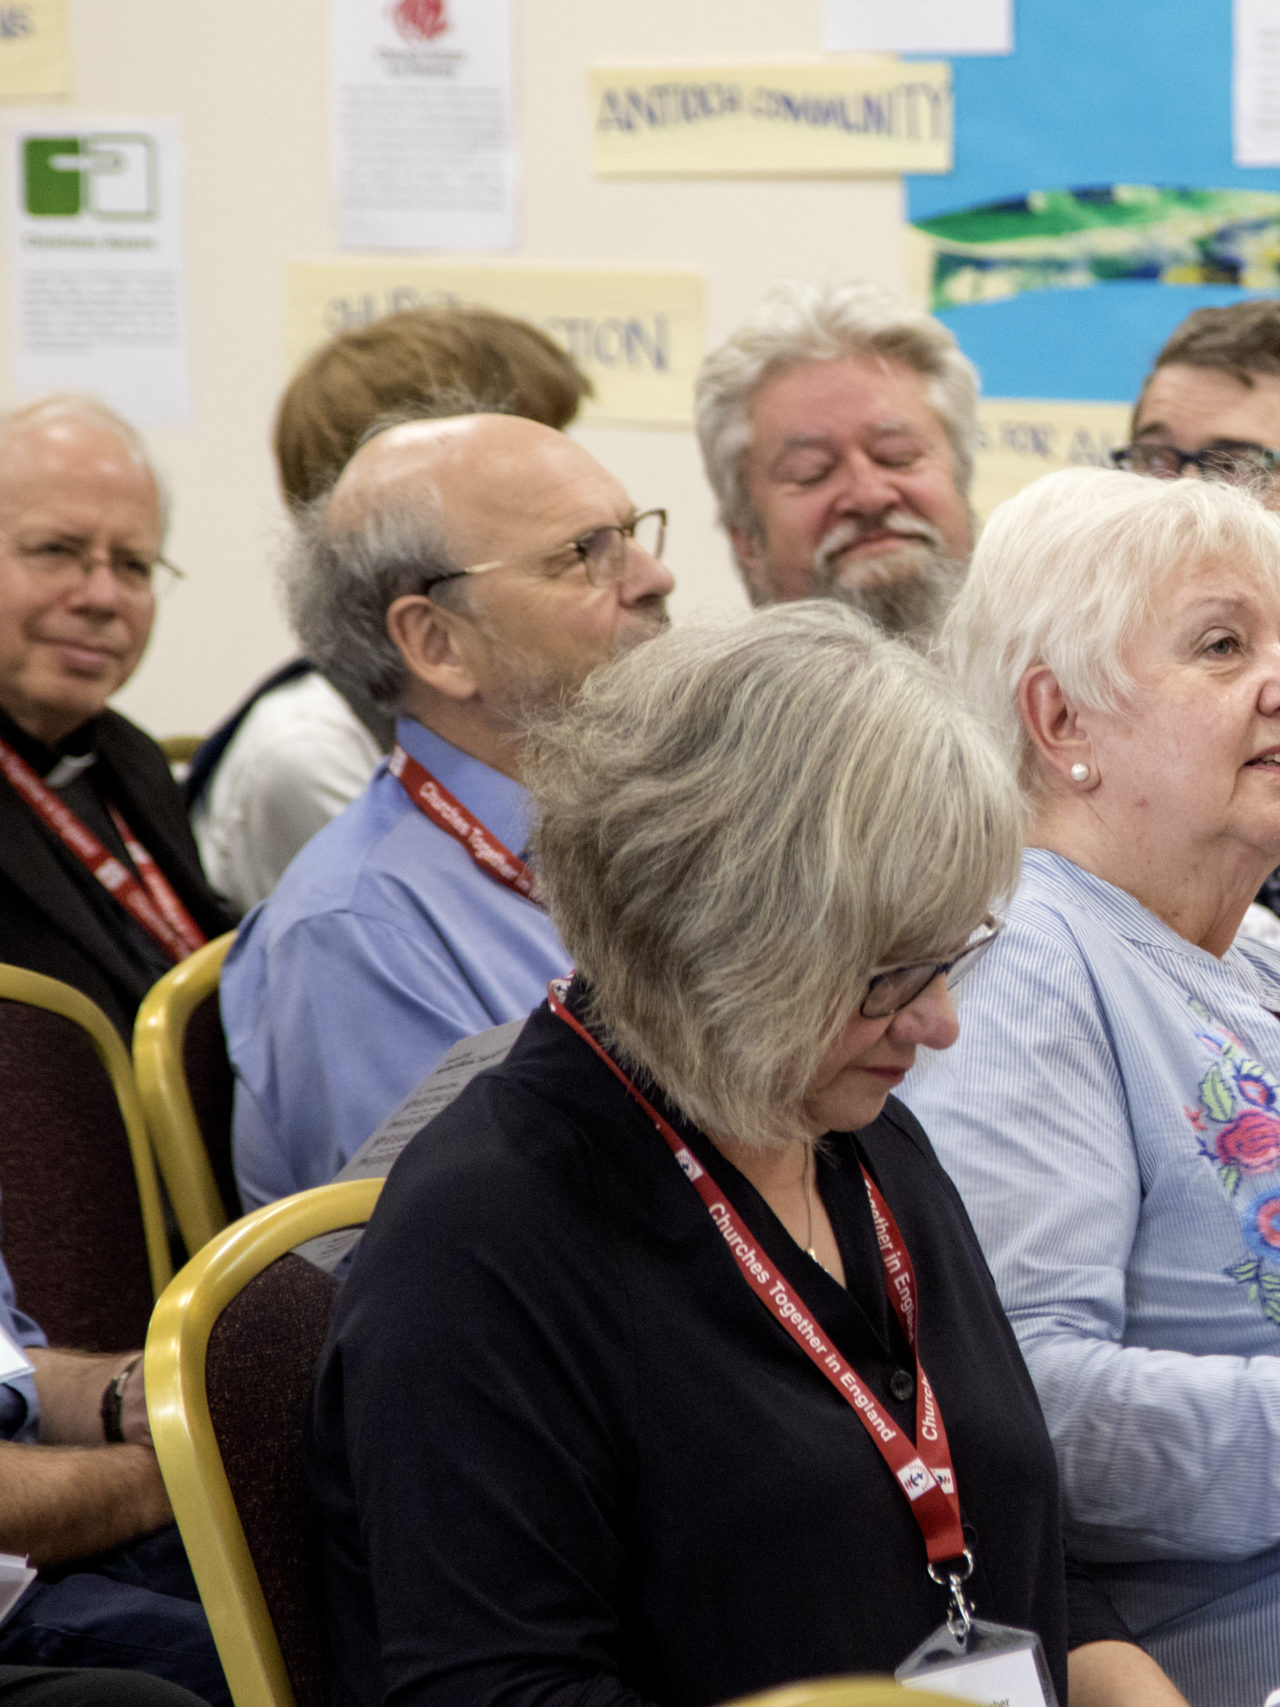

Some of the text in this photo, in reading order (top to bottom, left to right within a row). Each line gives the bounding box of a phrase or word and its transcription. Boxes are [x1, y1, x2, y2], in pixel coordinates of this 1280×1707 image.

[549, 312, 670, 371] TION
[420, 782, 470, 836] Churches
[884, 1251, 902, 1275] in
[708, 1202, 897, 1443] Churches Together in England
[921, 1373, 938, 1442] Church
